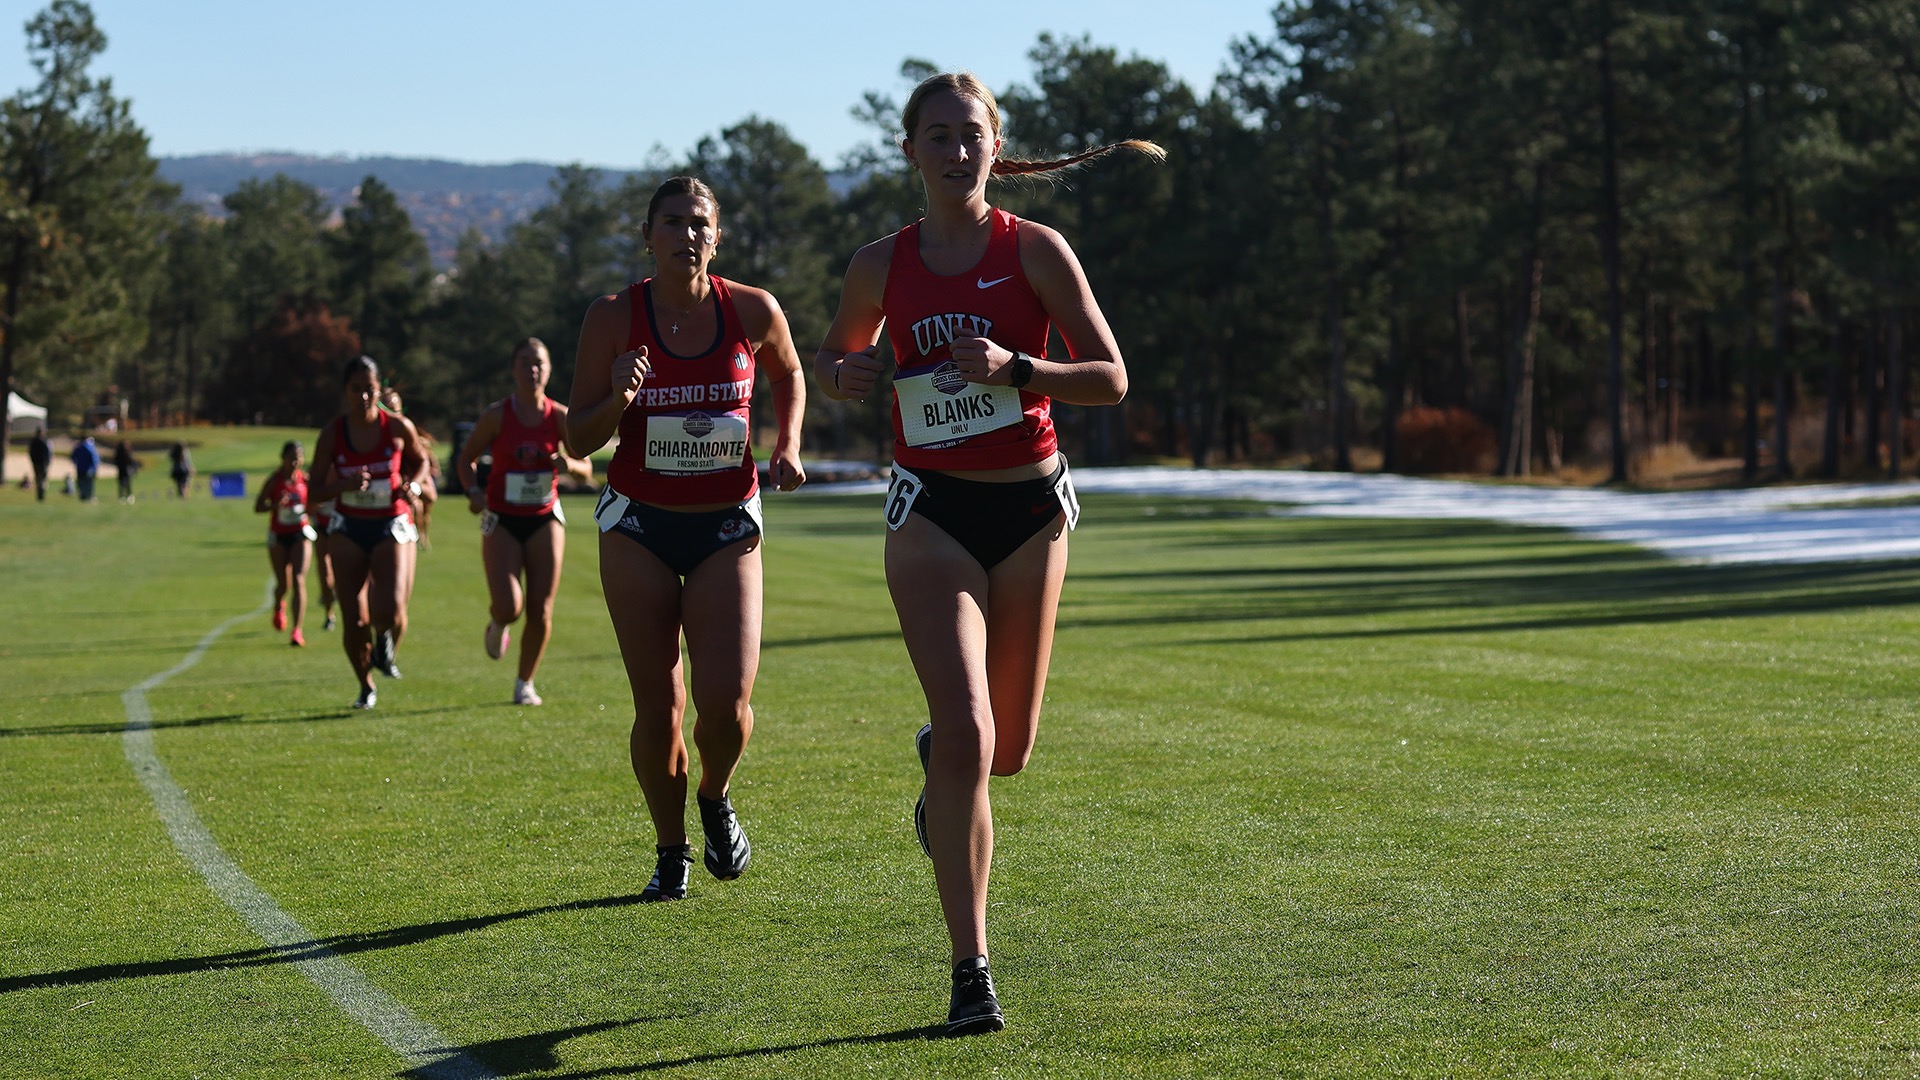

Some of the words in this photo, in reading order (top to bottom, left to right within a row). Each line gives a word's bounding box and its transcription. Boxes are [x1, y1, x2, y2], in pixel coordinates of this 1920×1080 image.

[636, 384, 705, 407] FRESNO
[709, 378, 752, 402] STATE
[923, 393, 994, 427] BLANKS
[951, 424, 968, 434] UNLV
[648, 440, 745, 458] CHIARAMONTE
[677, 460, 699, 468] FRESNO
[699, 460, 715, 468] STATE
